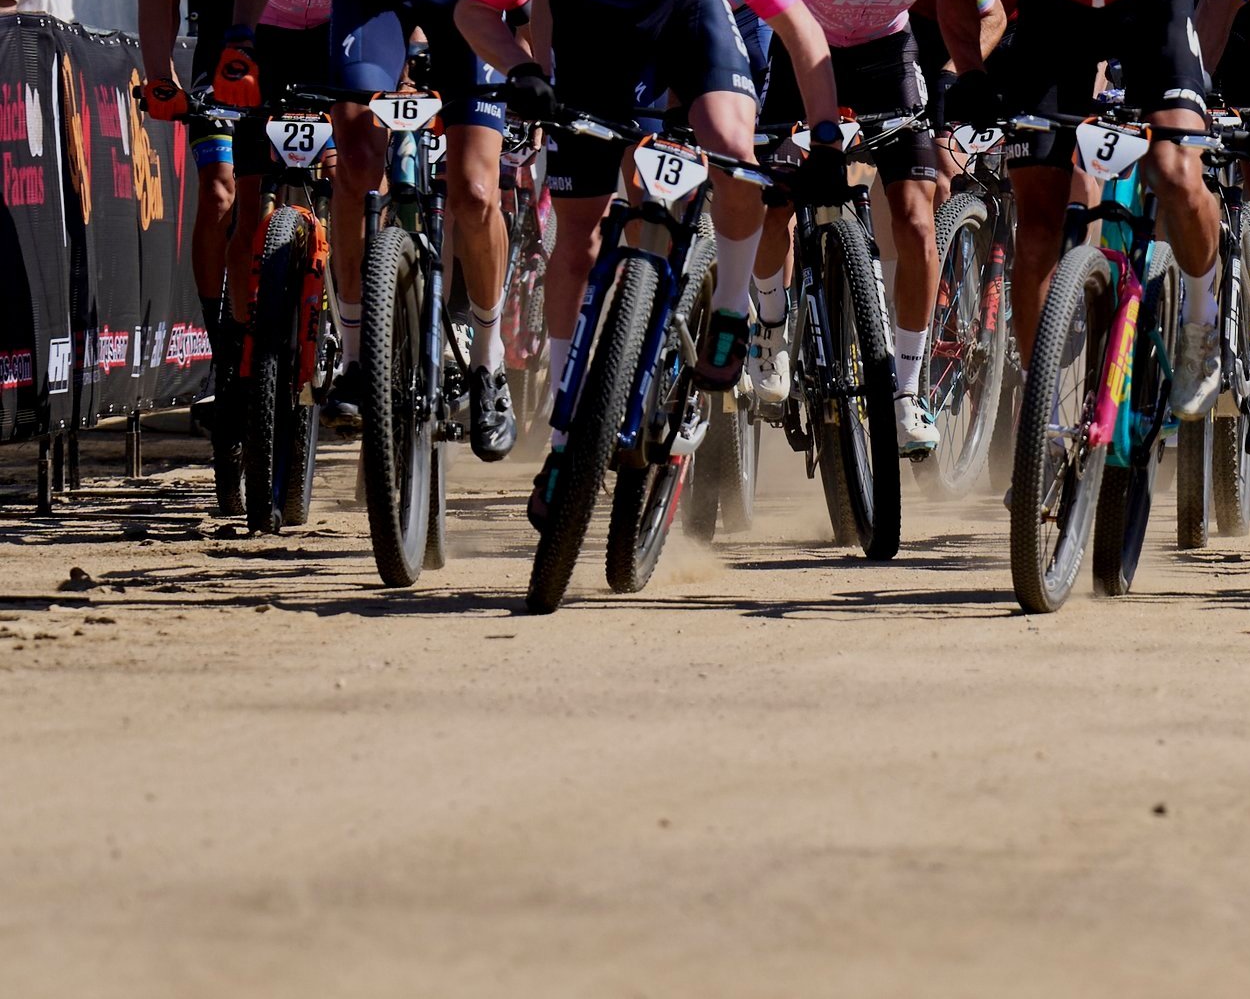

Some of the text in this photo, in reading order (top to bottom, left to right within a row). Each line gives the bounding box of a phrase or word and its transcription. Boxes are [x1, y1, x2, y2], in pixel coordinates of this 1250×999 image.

[391, 100, 419, 121] 16
[474, 101, 503, 119] JINGA
[283, 123, 316, 153] 23
[1096, 132, 1120, 162] 3
[654, 154, 683, 186] 13
